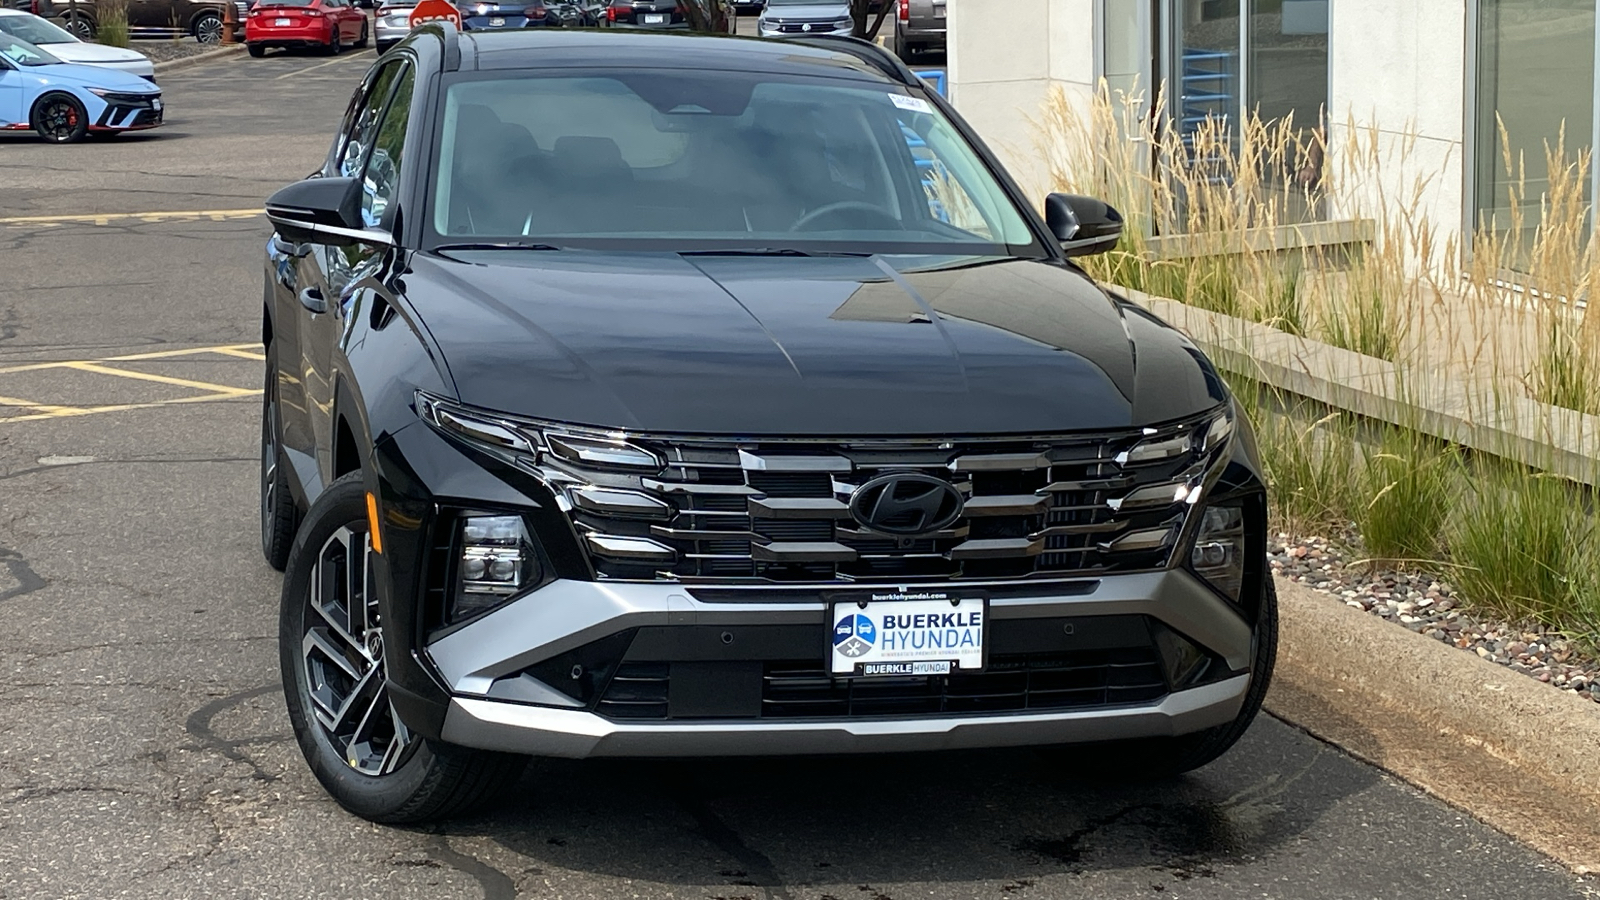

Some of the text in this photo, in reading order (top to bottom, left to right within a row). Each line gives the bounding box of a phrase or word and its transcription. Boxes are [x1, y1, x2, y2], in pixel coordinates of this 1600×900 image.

[872, 592, 947, 601] buerklehyundai.com
[883, 612, 981, 630] BUERKLE
[881, 628, 981, 650] HYUNDAI
[865, 662, 949, 674] BUERKLE HYUNDAI
